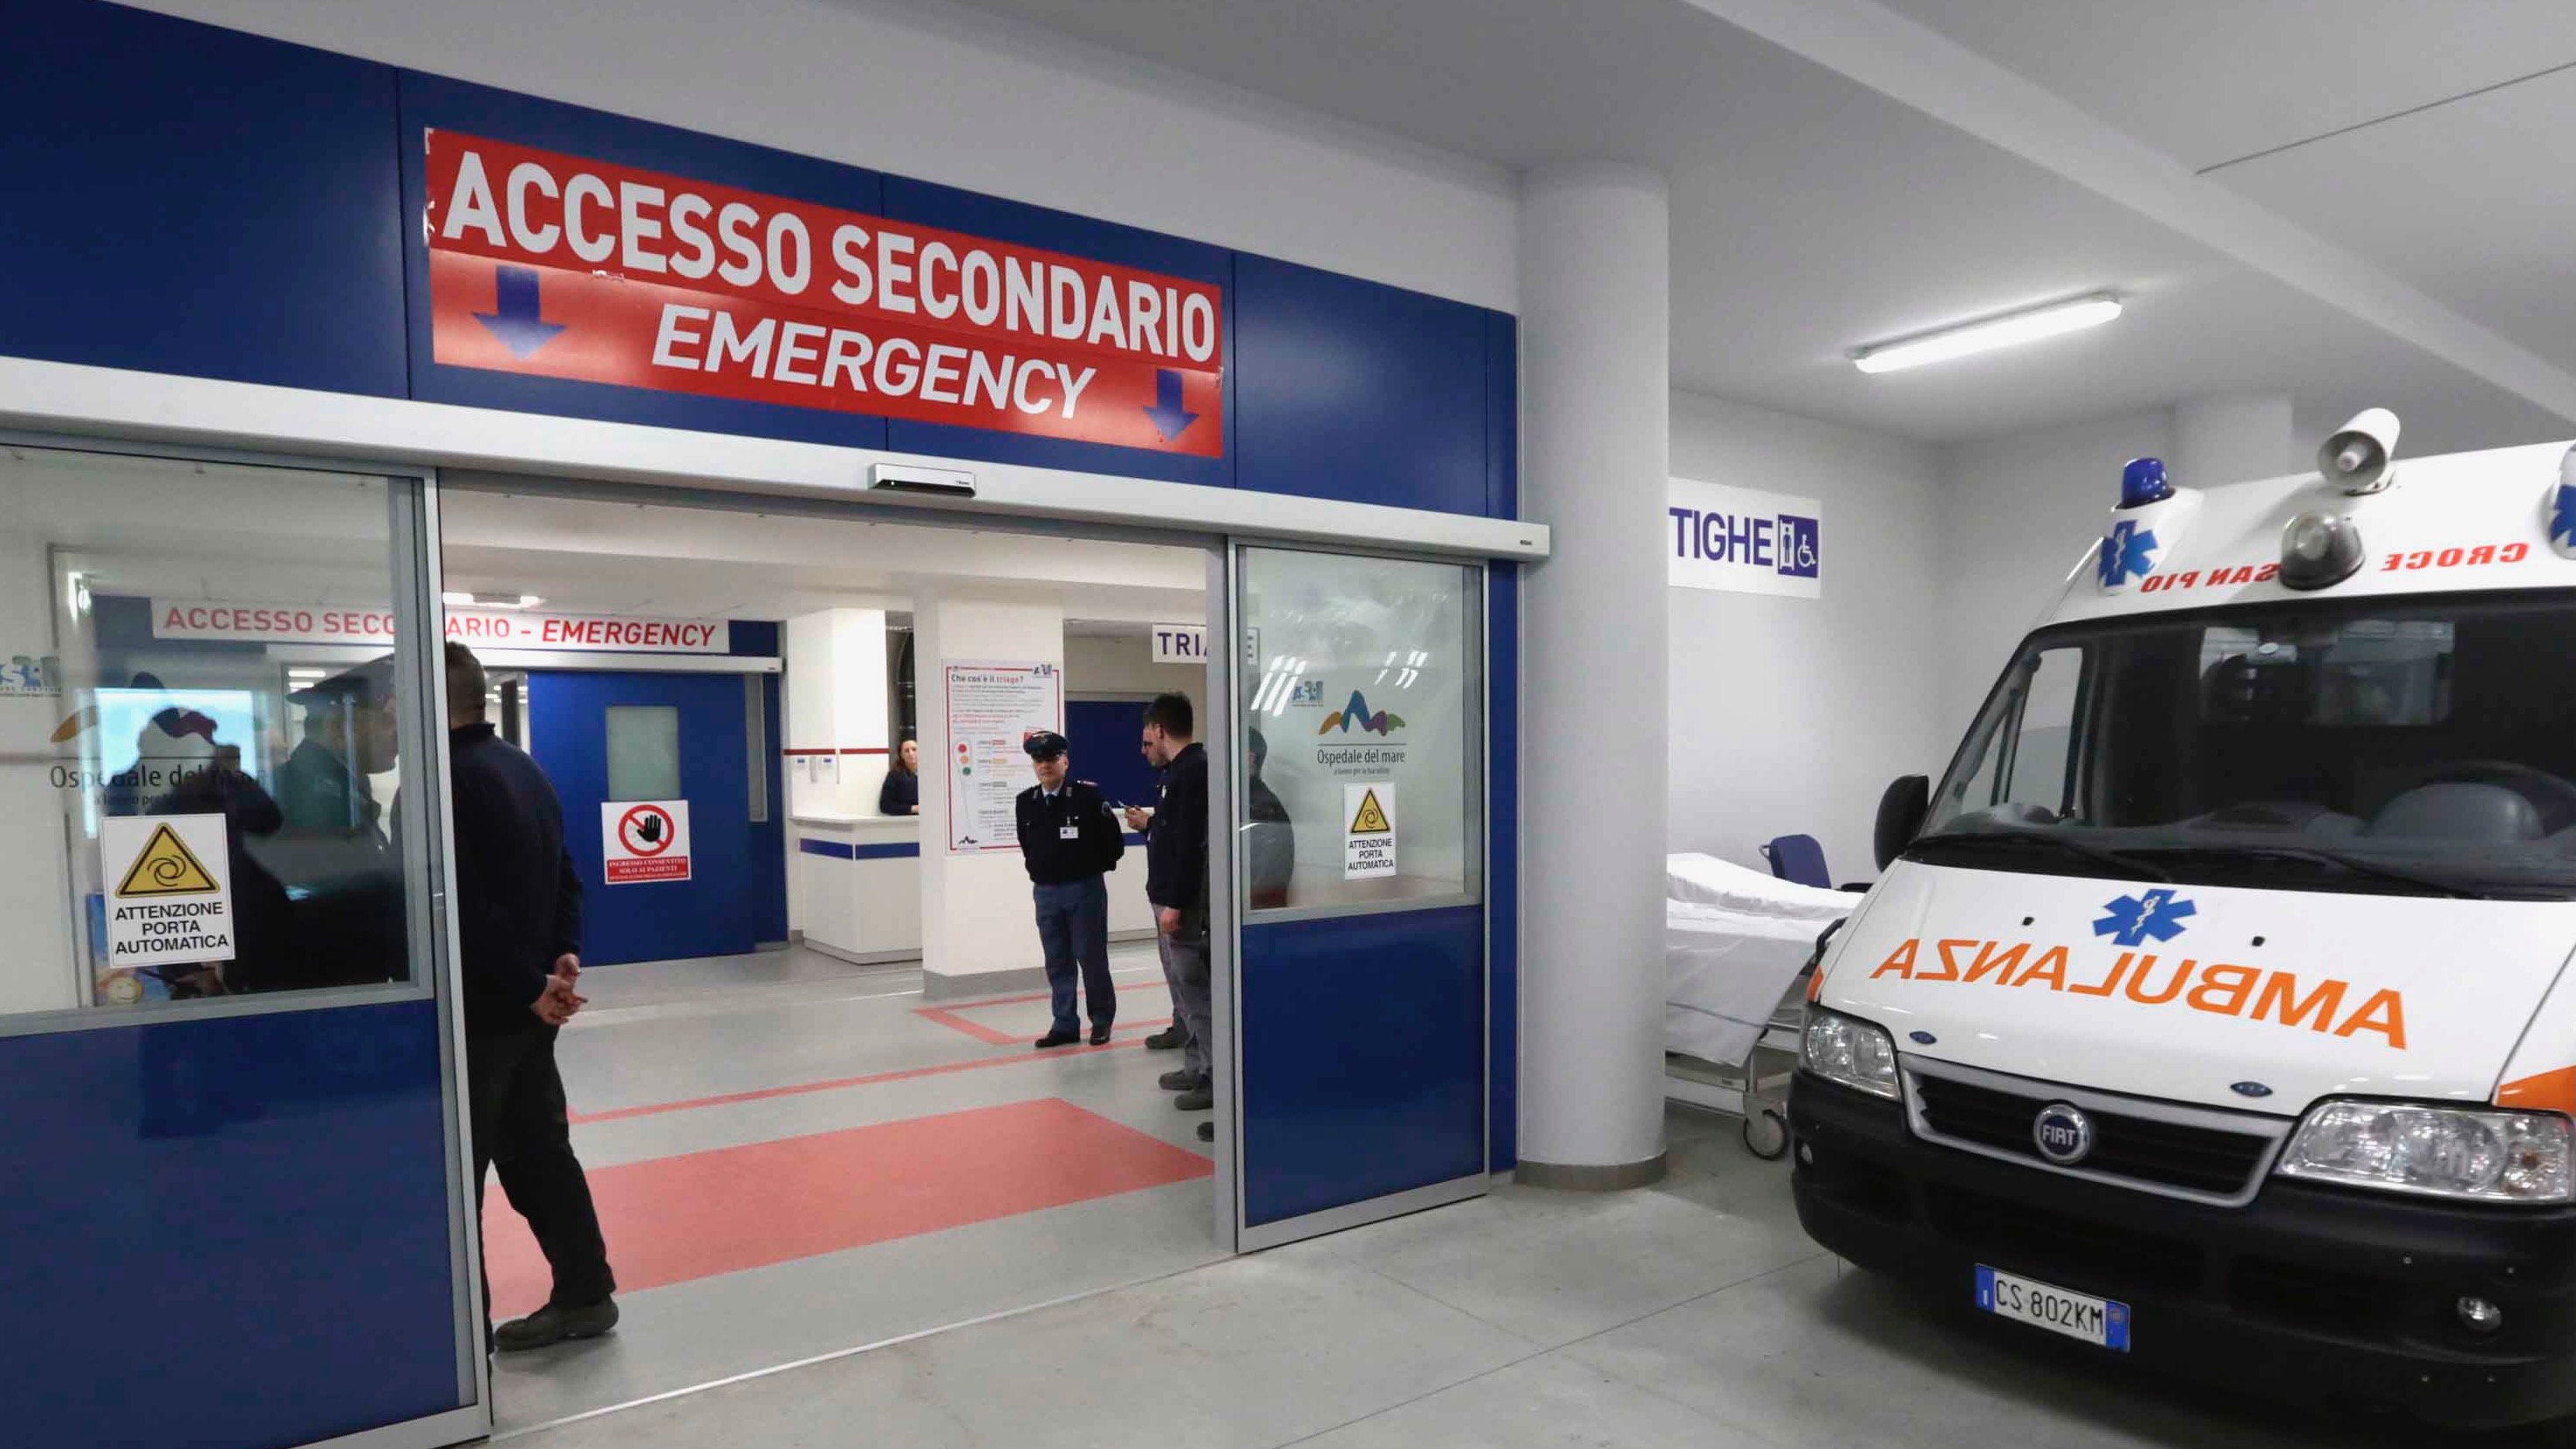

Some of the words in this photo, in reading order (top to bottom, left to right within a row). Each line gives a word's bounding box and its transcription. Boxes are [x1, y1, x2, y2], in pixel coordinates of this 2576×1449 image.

[442, 151, 811, 295] ACCESSO
[831, 224, 1215, 363] SECONDARIO
[652, 304, 1096, 419] EMERGENCY
[165, 608, 311, 632] ACCESSO
[542, 619, 715, 646] EMERGENCY
[1317, 749, 1363, 768] Ospedale
[1364, 749, 1379, 764] del
[1381, 751, 1405, 764] mare
[1349, 837, 1393, 849] ATTENZIONE
[1358, 849, 1383, 859] PORTA
[1348, 858, 1394, 871] AUTOMATICA
[115, 901, 222, 921] ATTENZIONE
[142, 919, 201, 936] PORTA
[115, 933, 229, 954] AUTOMATICA
[2042, 1124, 2076, 1146] FIAT
[1996, 1280, 2022, 1310] CS
[2031, 1291, 2104, 1336] 802KM
